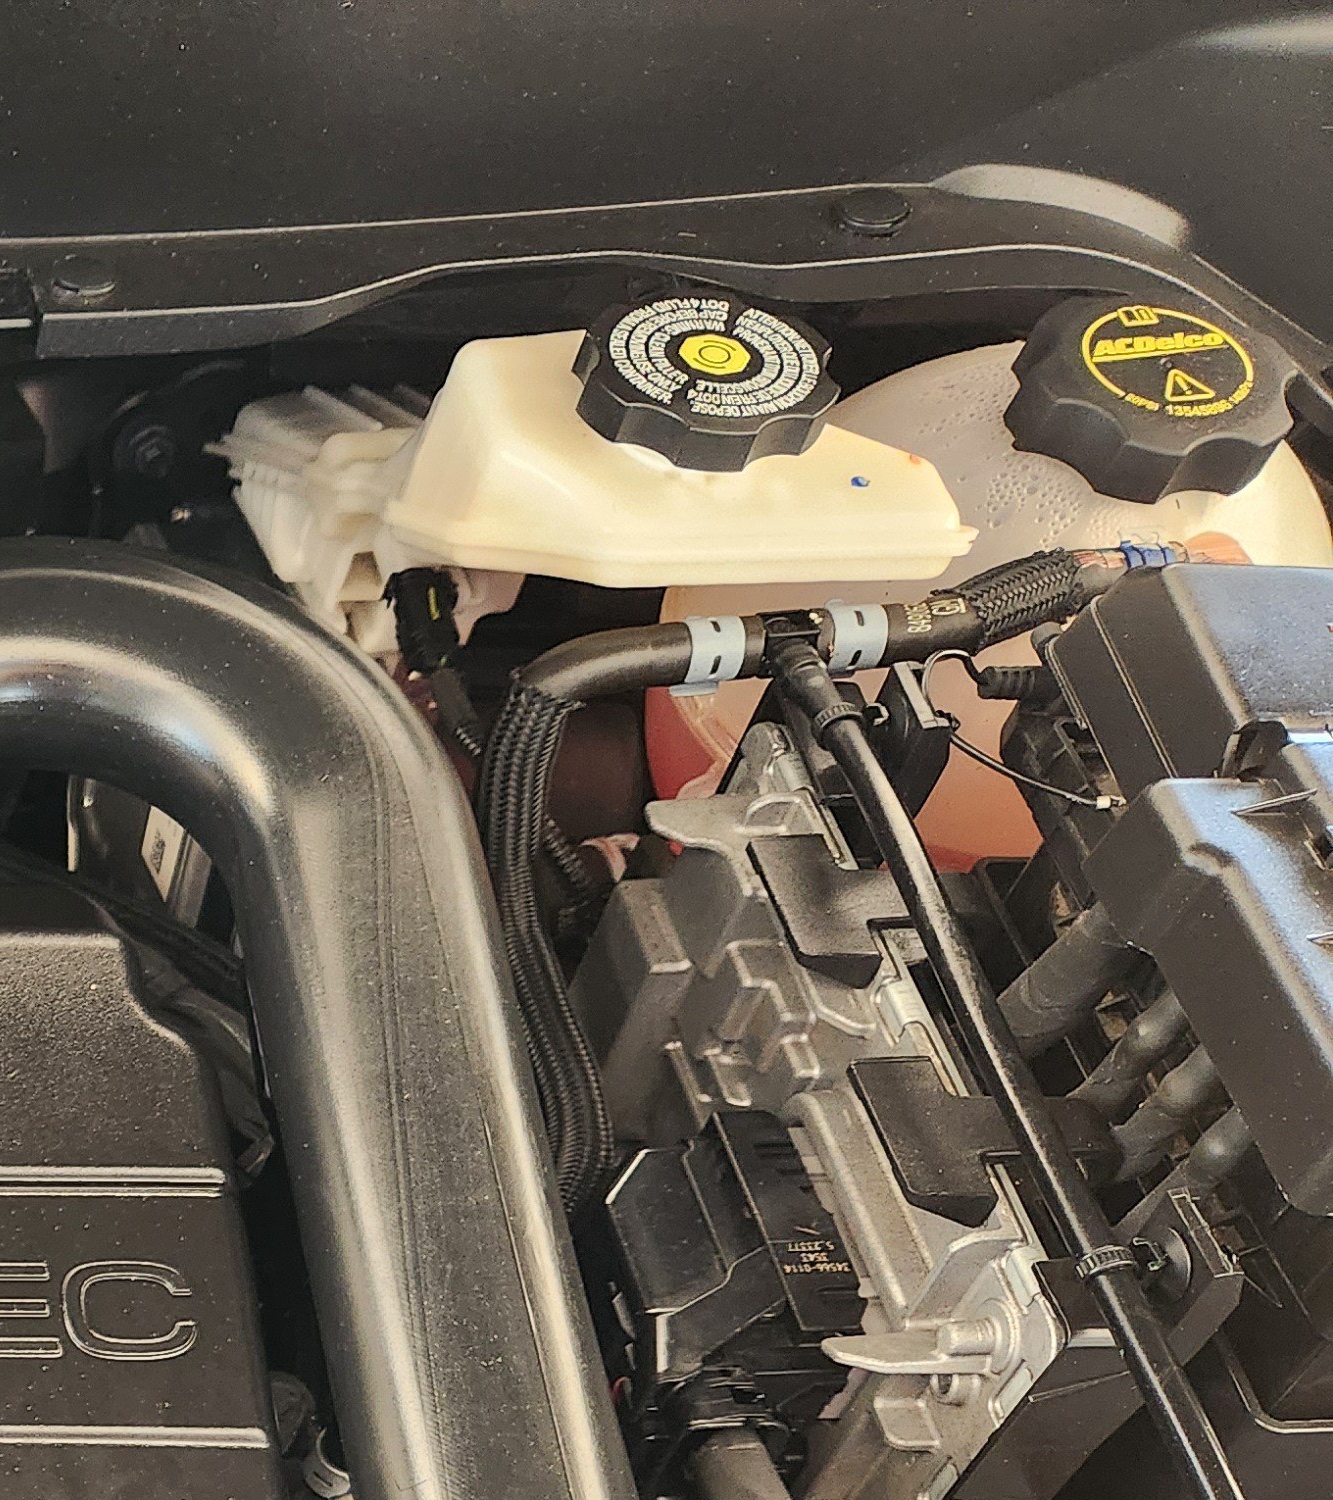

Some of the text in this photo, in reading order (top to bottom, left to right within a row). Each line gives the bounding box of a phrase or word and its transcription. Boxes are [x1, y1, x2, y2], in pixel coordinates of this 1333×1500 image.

[652, 298, 692, 313] FLUID
[689, 298, 700, 308] 4
[700, 299, 730, 312] DOT
[698, 309, 728, 322] CAP
[1093, 332, 1224, 356] ACDelco
[695, 392, 721, 404] DOT
[721, 393, 758, 406] FREIN
[740, 401, 779, 417] AVANT
